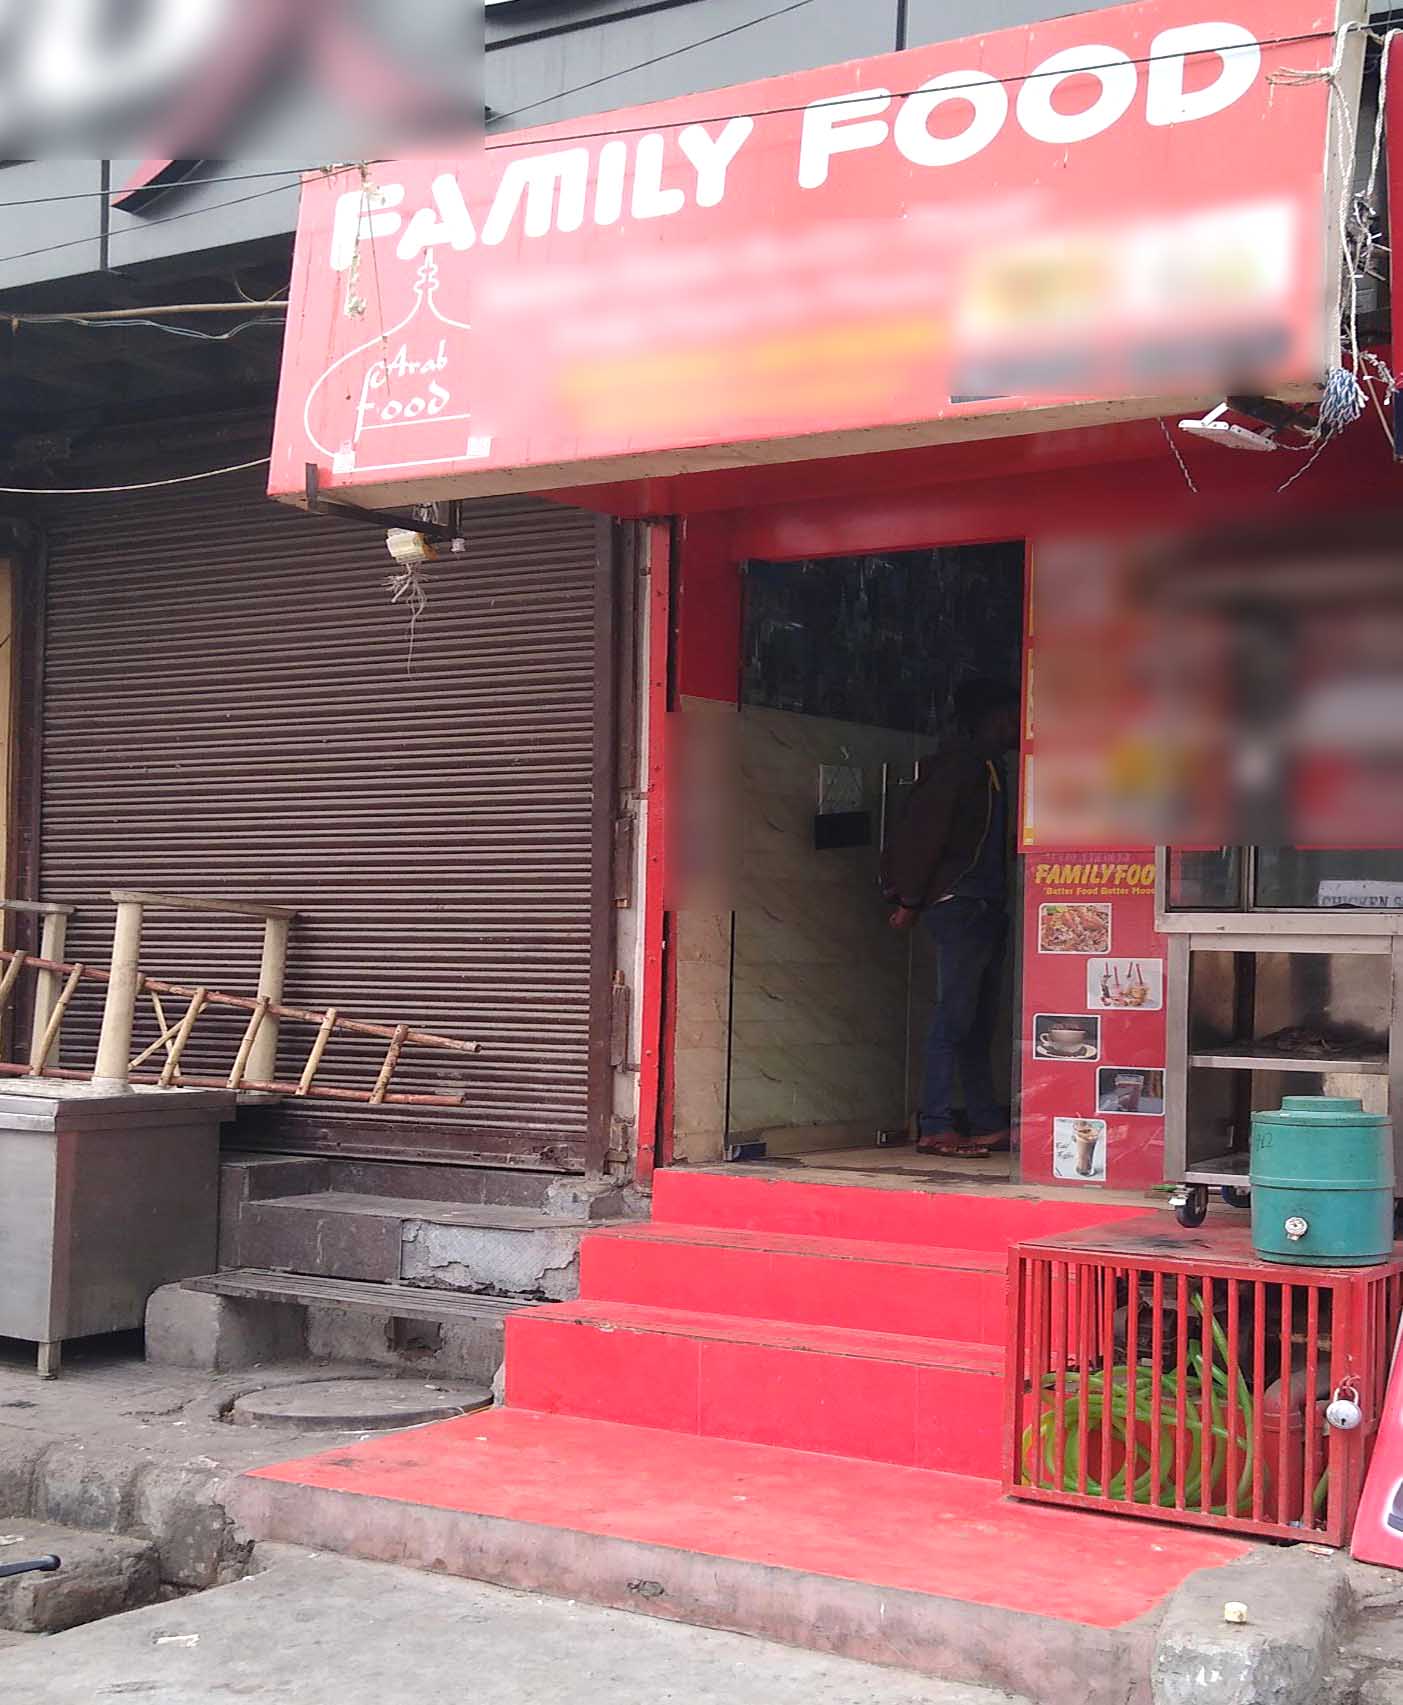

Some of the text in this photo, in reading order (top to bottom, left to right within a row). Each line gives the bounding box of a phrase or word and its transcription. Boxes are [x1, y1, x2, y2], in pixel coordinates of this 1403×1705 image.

[330, 22, 1261, 271] FAMILY FOOD
[1035, 863, 1114, 884] FAMILY
